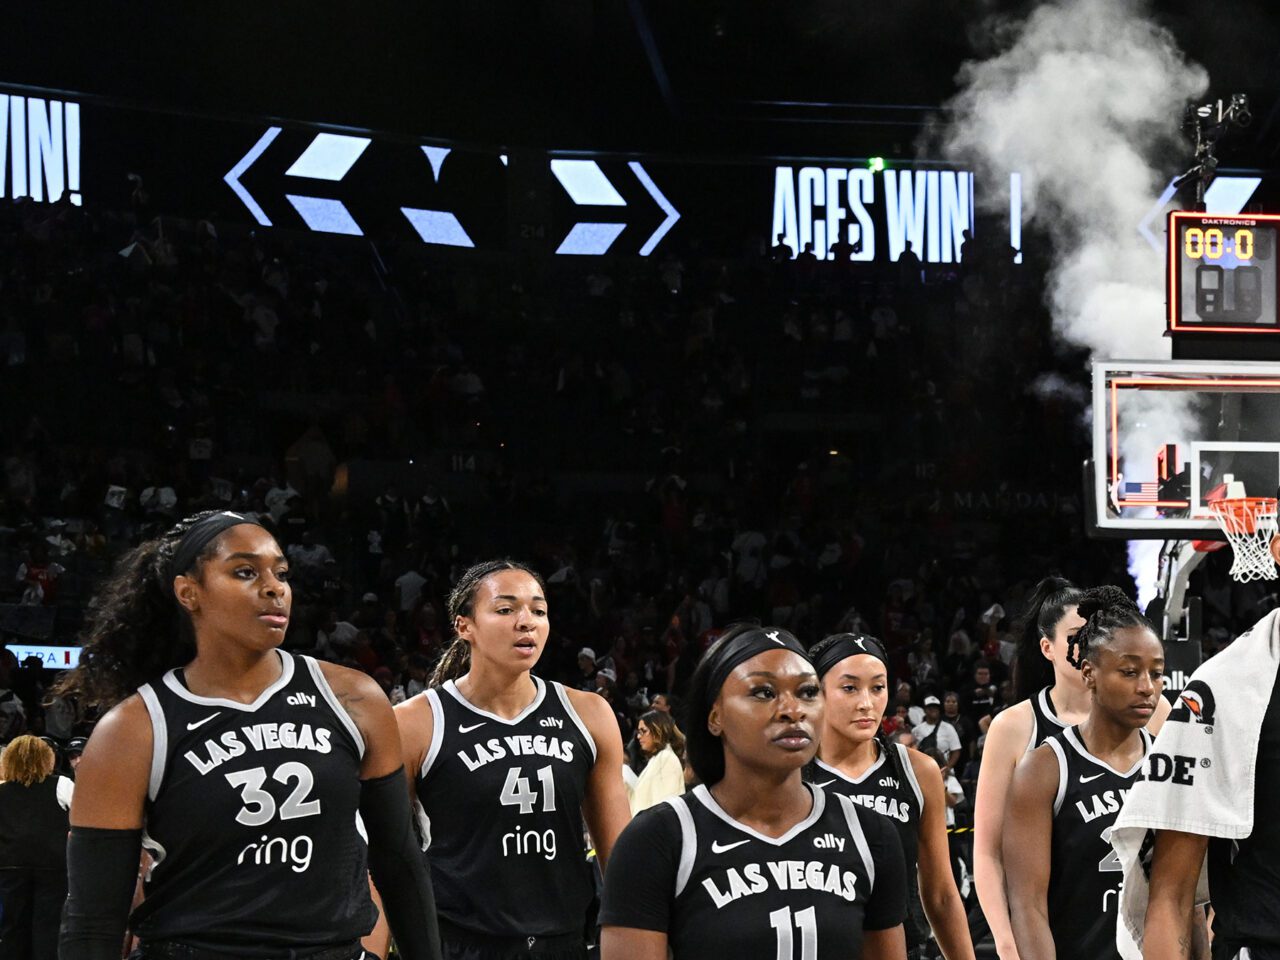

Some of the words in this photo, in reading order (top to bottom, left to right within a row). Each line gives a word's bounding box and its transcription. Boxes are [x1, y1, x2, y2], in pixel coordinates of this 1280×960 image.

[0, 93, 83, 207] IN!
[771, 166, 875, 262] ACES
[1201, 218, 1257, 226] DAKTRONICS
[286, 692, 316, 708] ally
[539, 717, 564, 729] ally
[184, 730, 246, 776] LAS
[241, 722, 332, 754] VEGAS
[457, 738, 507, 772] LAS
[503, 734, 574, 763] VEGAS
[224, 761, 321, 827] 32
[499, 764, 556, 815] 41
[878, 776, 900, 790] ally
[1075, 790, 1120, 823] LAS
[237, 834, 314, 873] ring
[502, 825, 557, 861] ring
[813, 833, 846, 852] ally
[701, 862, 769, 910] LAS
[766, 860, 858, 902] VEGAS
